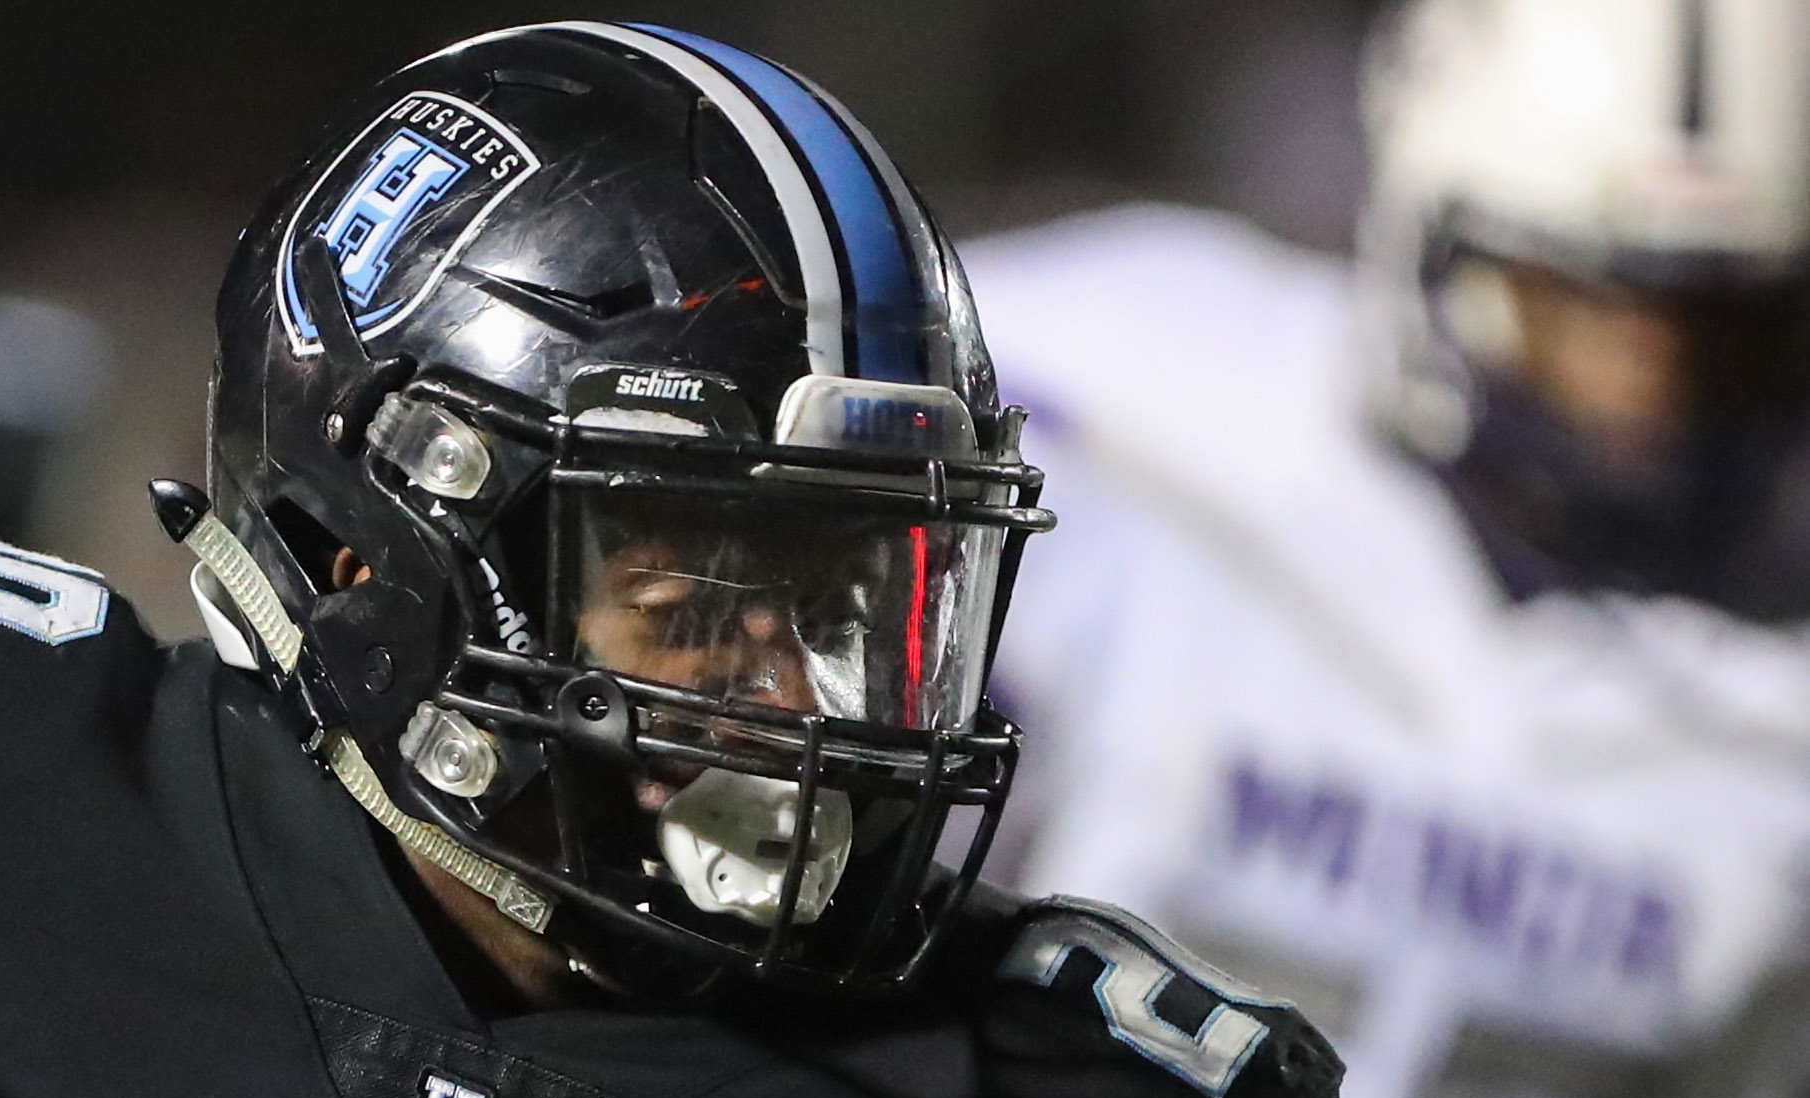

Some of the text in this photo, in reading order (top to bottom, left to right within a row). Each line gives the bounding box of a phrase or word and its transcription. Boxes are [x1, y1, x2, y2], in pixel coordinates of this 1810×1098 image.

[389, 99, 519, 181] HUSKIES
[312, 126, 472, 308] H
[615, 371, 705, 402] schutt
